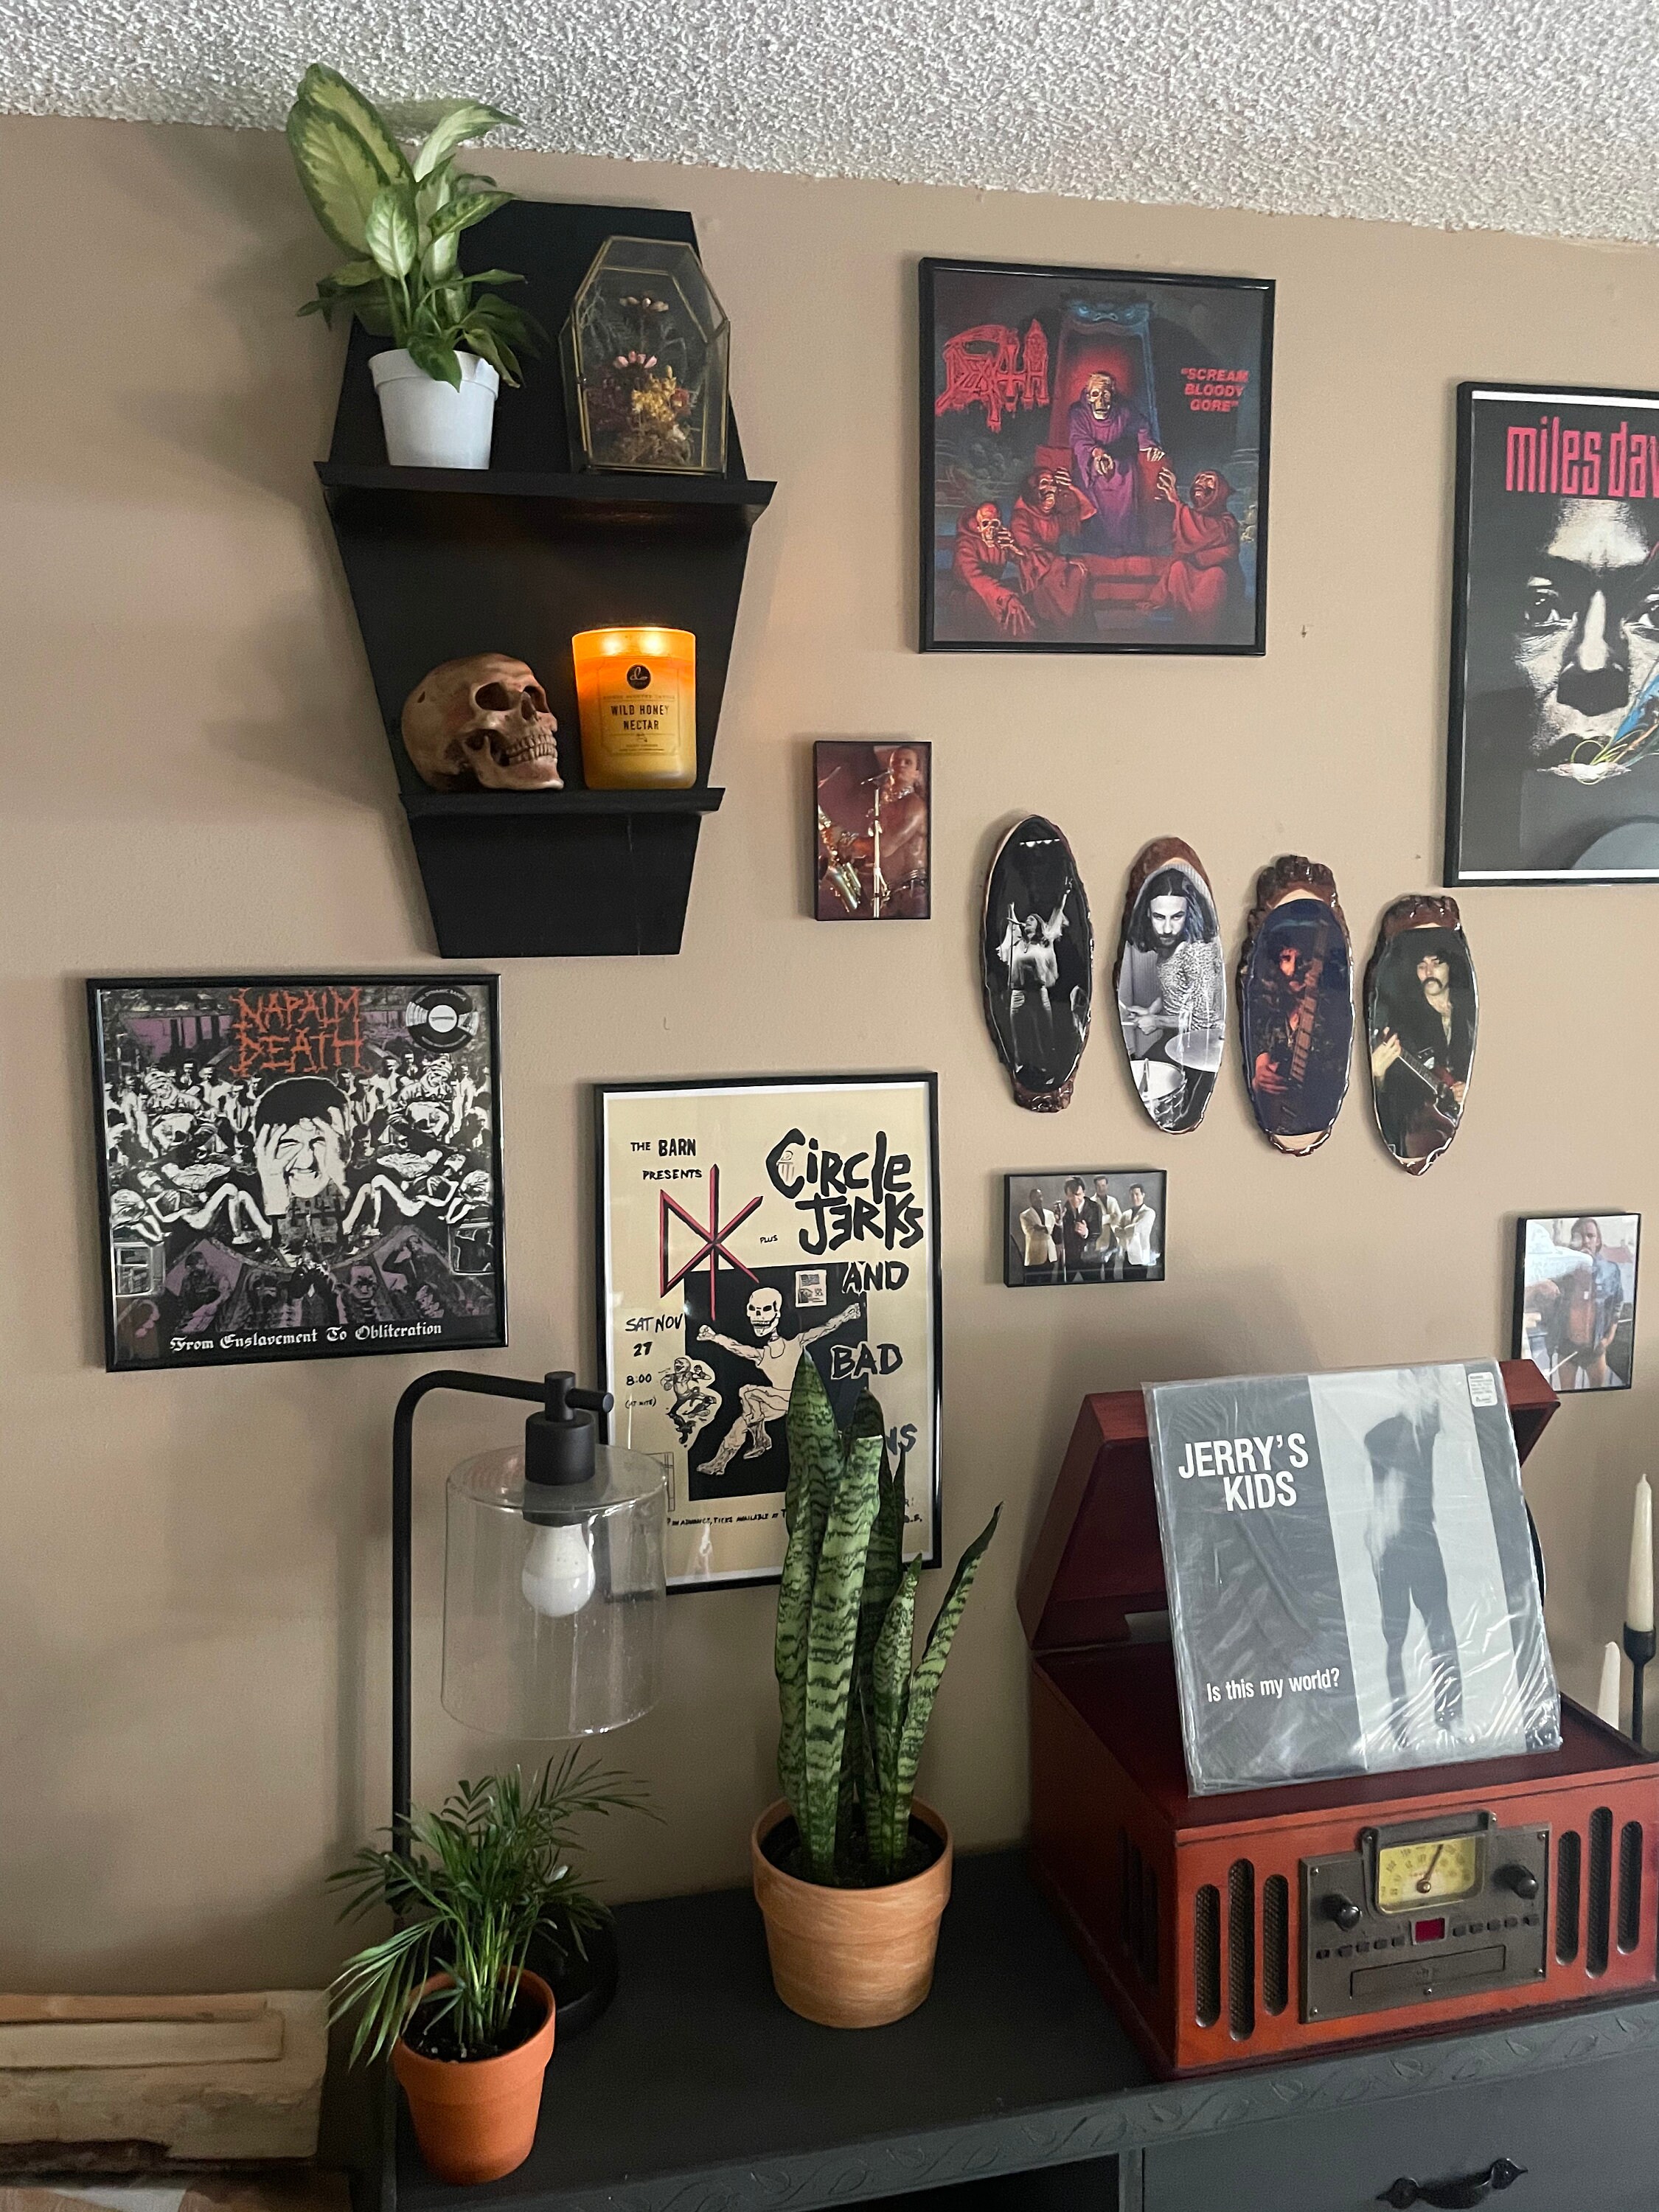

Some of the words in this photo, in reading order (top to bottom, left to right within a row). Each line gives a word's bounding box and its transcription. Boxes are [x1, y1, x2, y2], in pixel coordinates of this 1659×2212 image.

[1184, 383, 1245, 397] BLOODY
[1190, 399, 1239, 412] GORE"
[1506, 416, 1601, 495] miles
[611, 704, 635, 715] WILD
[639, 705, 669, 715] HONEY
[623, 720, 659, 730] NECTAR
[229, 987, 362, 1032] NAPALM
[229, 1027, 366, 1077] DEATH
[630, 1141, 651, 1152] THE
[658, 1138, 696, 1156] BARN
[642, 1169, 703, 1180] PRESENTS
[795, 1192, 924, 1256] JERKS
[759, 1234, 779, 1244] PLUS
[842, 1261, 910, 1293] AND
[625, 1317, 654, 1332] SAT
[655, 1313, 683, 1333] NOV
[170, 1336, 214, 1352] From
[220, 1328, 318, 1349] Enslavement
[326, 1326, 347, 1341] To
[355, 1322, 442, 1340] Obliteration
[633, 1341, 653, 1357] 27
[832, 1343, 903, 1379] BAD
[626, 1373, 652, 1385] 8:00
[1178, 1433, 1309, 1479] JERRY'S
[1223, 1470, 1297, 1512] KIDS
[1206, 1683, 1222, 1703] Is
[1225, 1678, 1254, 1700] this
[1259, 1678, 1283, 1699] my
[1288, 1667, 1340, 1692] world?
